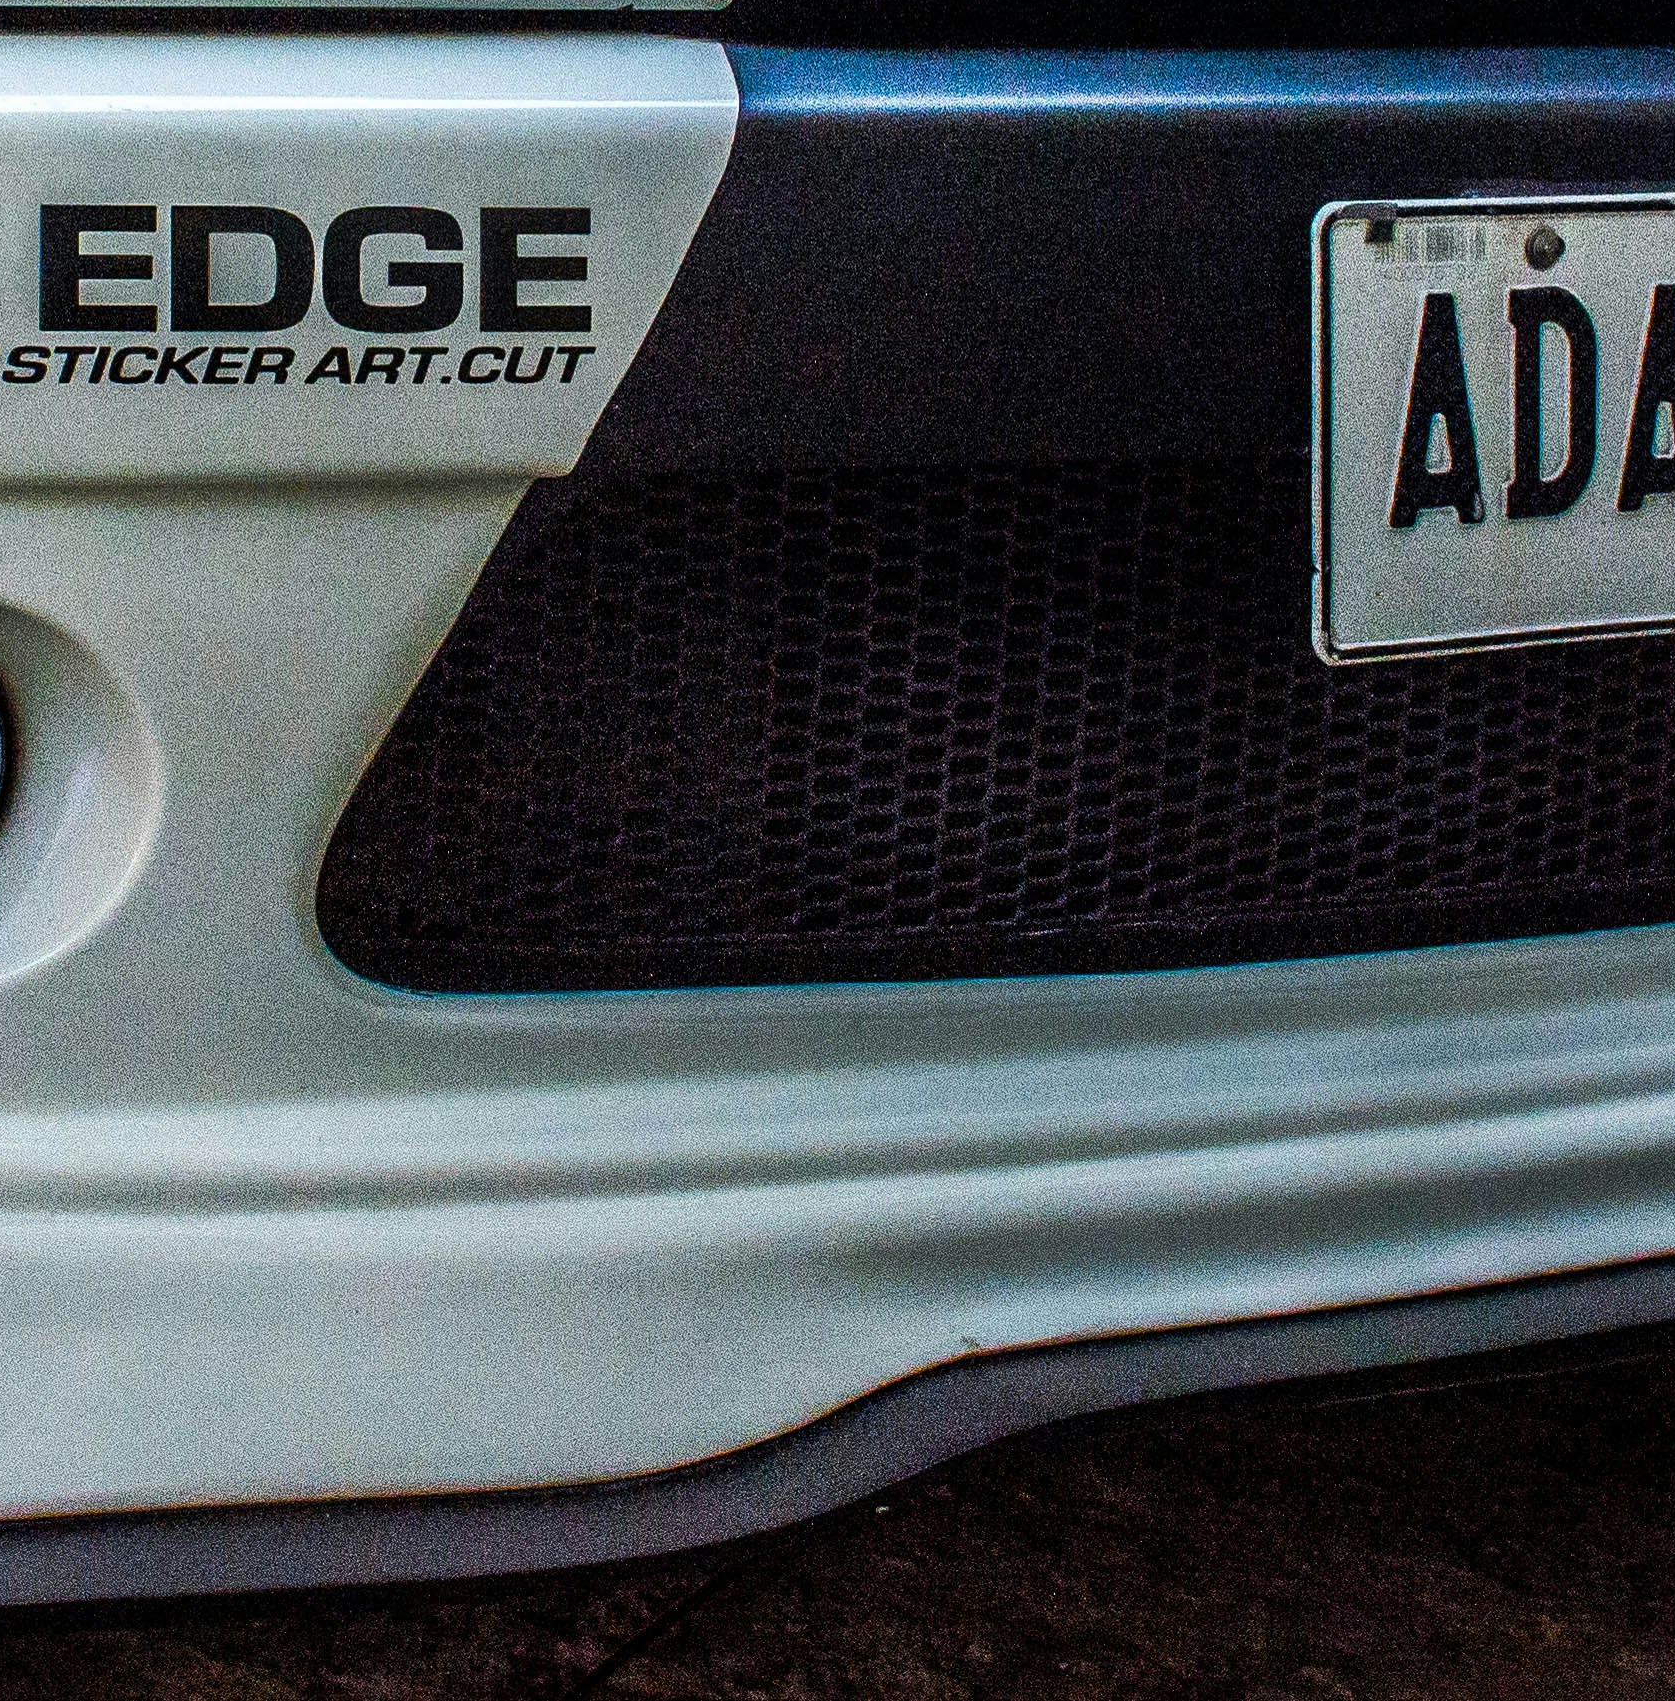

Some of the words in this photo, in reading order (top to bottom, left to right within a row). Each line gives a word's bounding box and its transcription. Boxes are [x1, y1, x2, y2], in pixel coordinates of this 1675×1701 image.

[37, 203, 593, 336] EDGE
[1, 345, 297, 386] STICKER
[304, 345, 596, 386] ART.CUT
